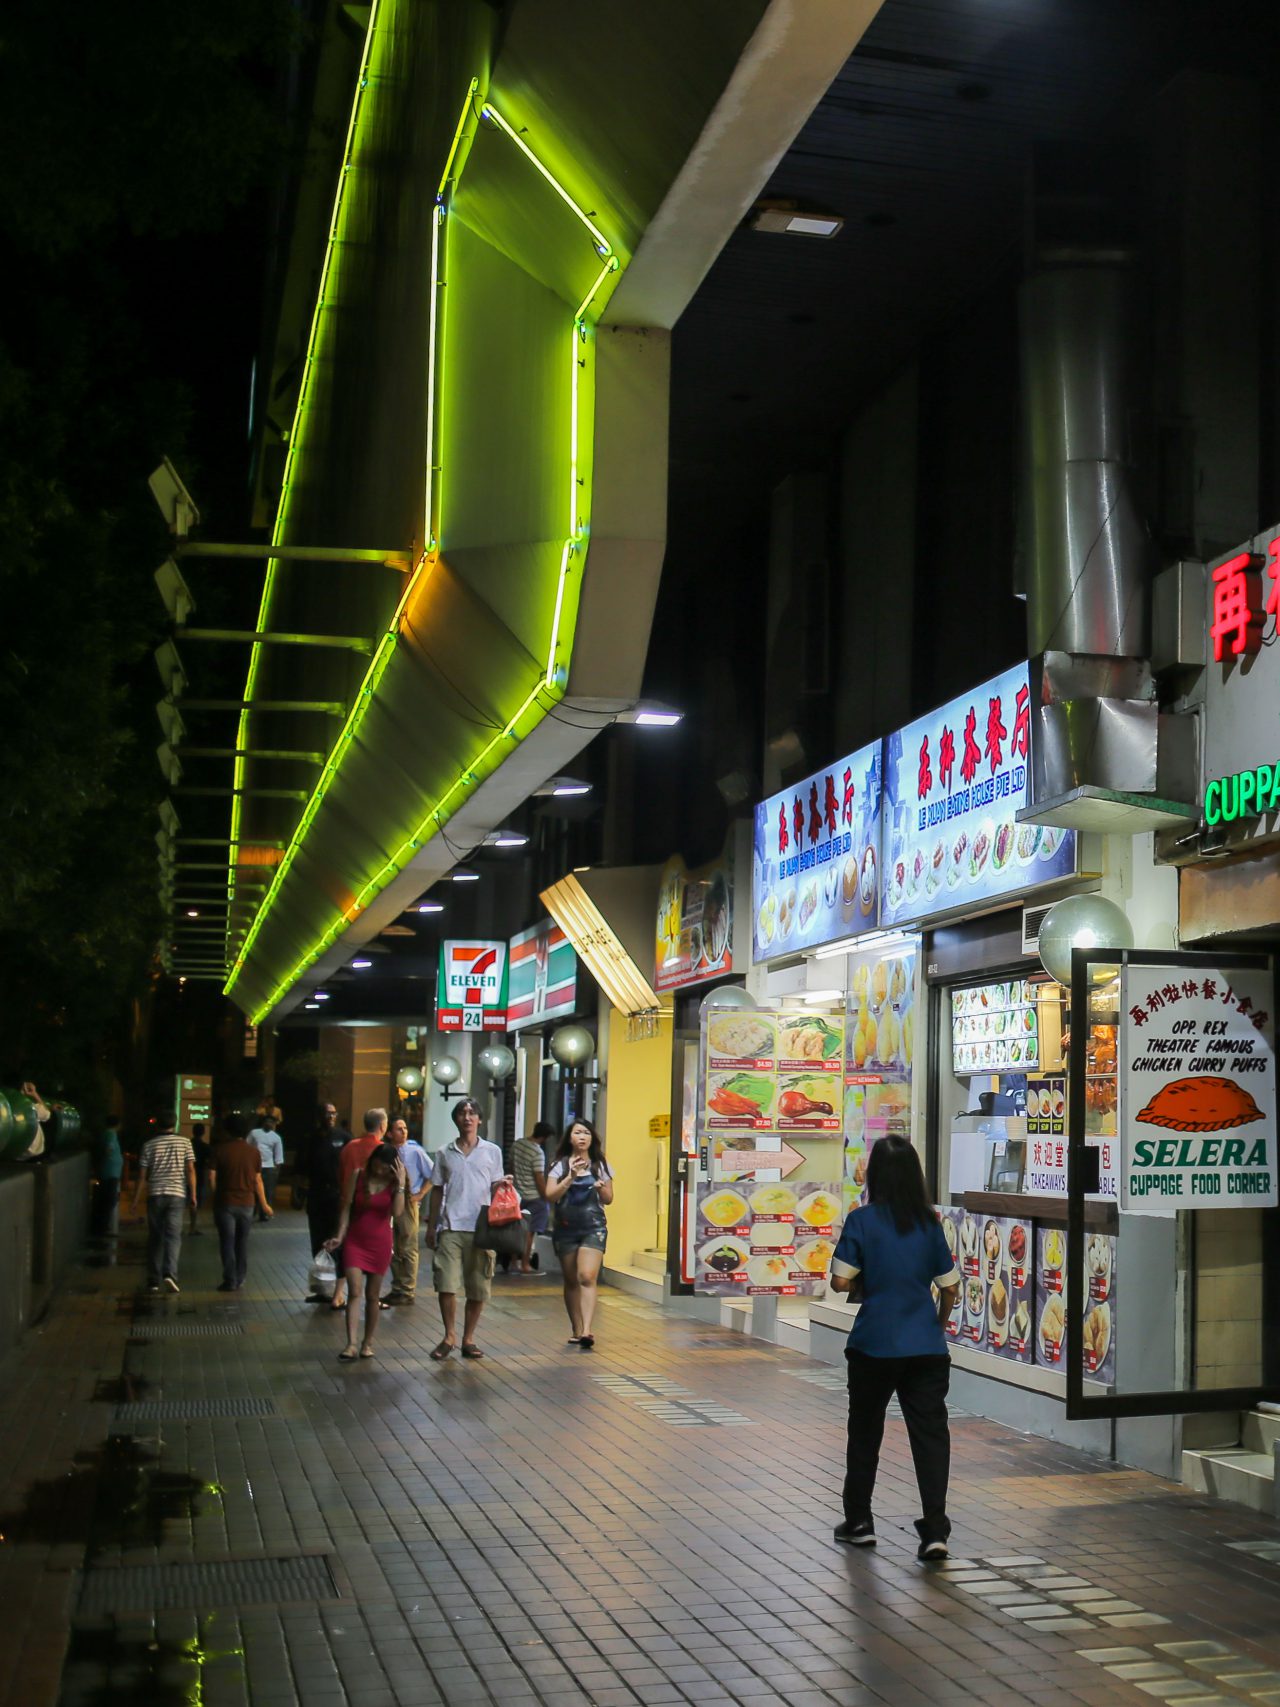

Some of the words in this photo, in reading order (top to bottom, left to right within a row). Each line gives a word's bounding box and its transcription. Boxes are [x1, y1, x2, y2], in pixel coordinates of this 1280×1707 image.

[918, 806, 927, 831] LE
[927, 798, 947, 828] XUAN
[947, 788, 970, 820] EATING
[971, 777, 994, 809] HOUSE
[995, 770, 1010, 800] PTE
[1011, 764, 1026, 794] LTD
[452, 947, 497, 1004] 7
[464, 1012, 481, 1026] 24
[1172, 1020, 1197, 1035] OPP.
[1203, 1021, 1228, 1035] REX
[1147, 1038, 1200, 1053] THEATRE
[1206, 1039, 1256, 1054] FAMOUS
[1131, 1057, 1183, 1072] CHICKEN
[1188, 1057, 1226, 1072] CURRY
[1230, 1057, 1268, 1073] PUFFS
[1131, 1138, 1268, 1167] SELERA
[1030, 1173, 1066, 1191] TAKEAWAYS
[1130, 1173, 1184, 1196] CUPPAGE
[1191, 1173, 1221, 1194] FOOD
[1227, 1171, 1271, 1194] CORNER
